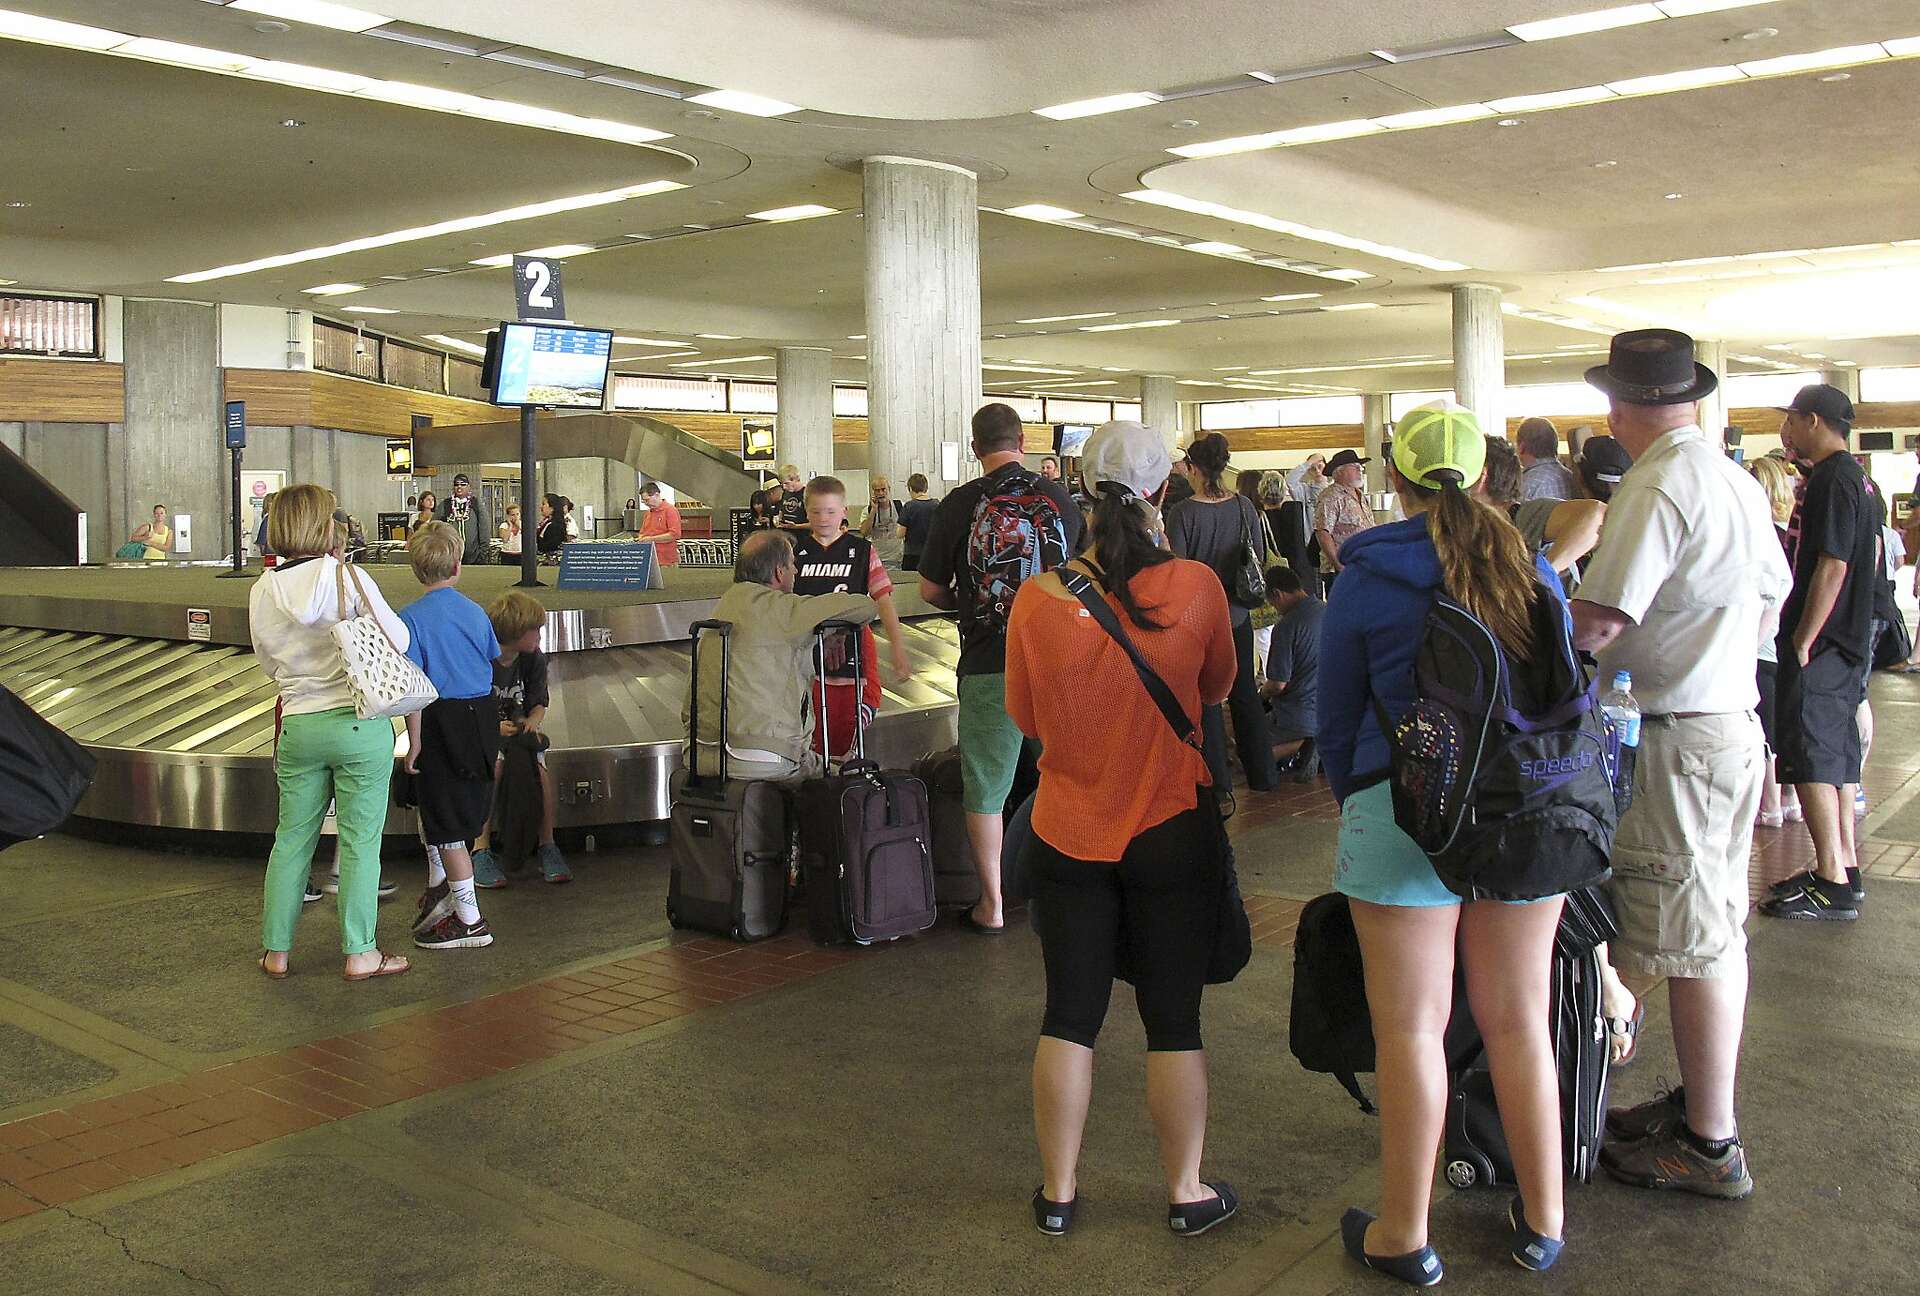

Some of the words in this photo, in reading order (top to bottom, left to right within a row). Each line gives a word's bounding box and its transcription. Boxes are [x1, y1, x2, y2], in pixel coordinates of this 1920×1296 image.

[526, 261, 553, 308] 2
[508, 348, 525, 373] 2
[800, 563, 852, 577] MIAMI
[1520, 751, 1592, 780] speedo
